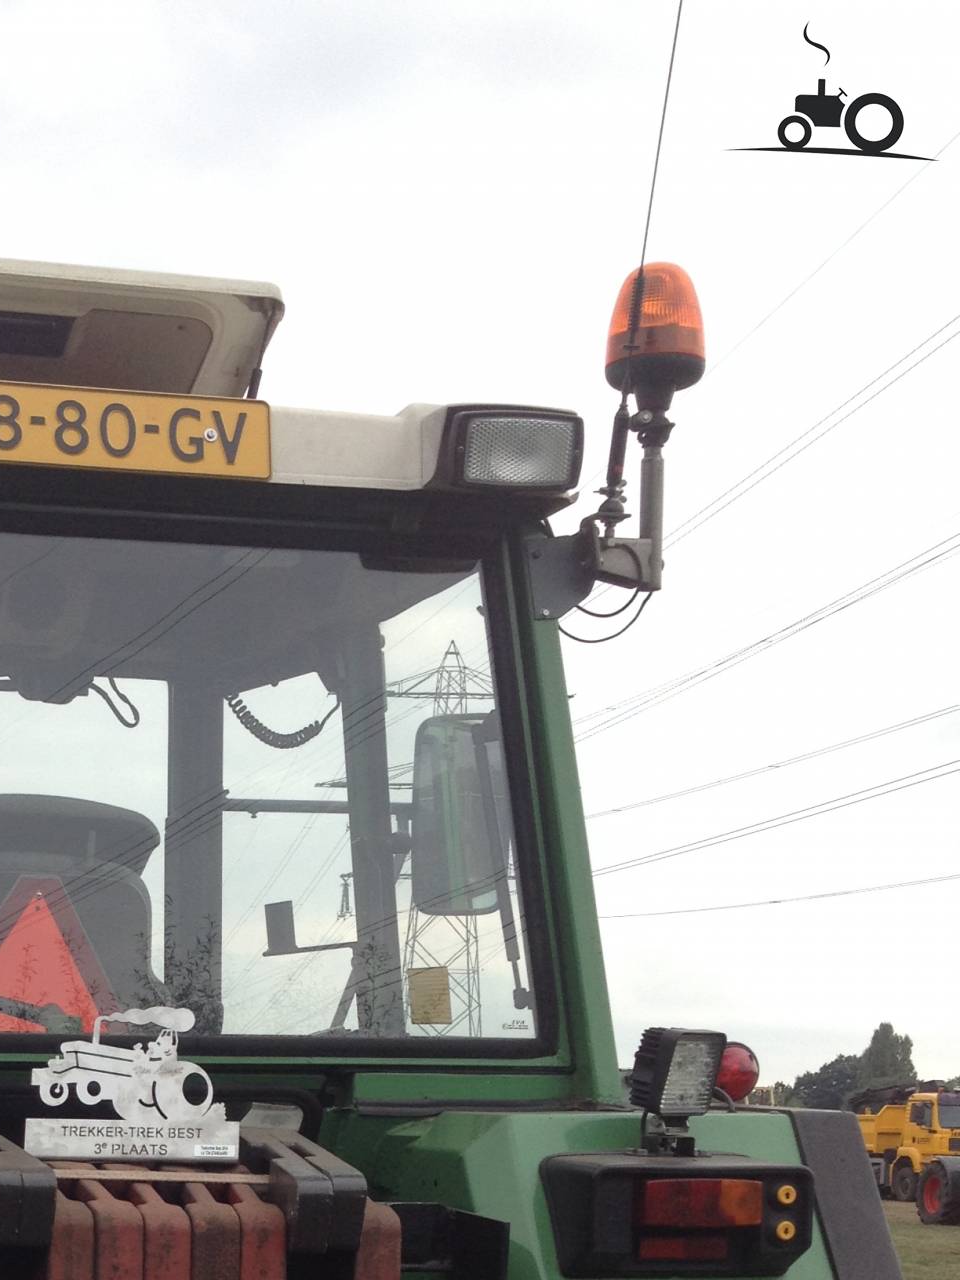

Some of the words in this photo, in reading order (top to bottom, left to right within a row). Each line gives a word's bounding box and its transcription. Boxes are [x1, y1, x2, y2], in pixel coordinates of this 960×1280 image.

[61, 1125, 165, 1139] TREKKER-TREK
[168, 1127, 204, 1139] BEST
[111, 1144, 168, 1156] PLAATS
